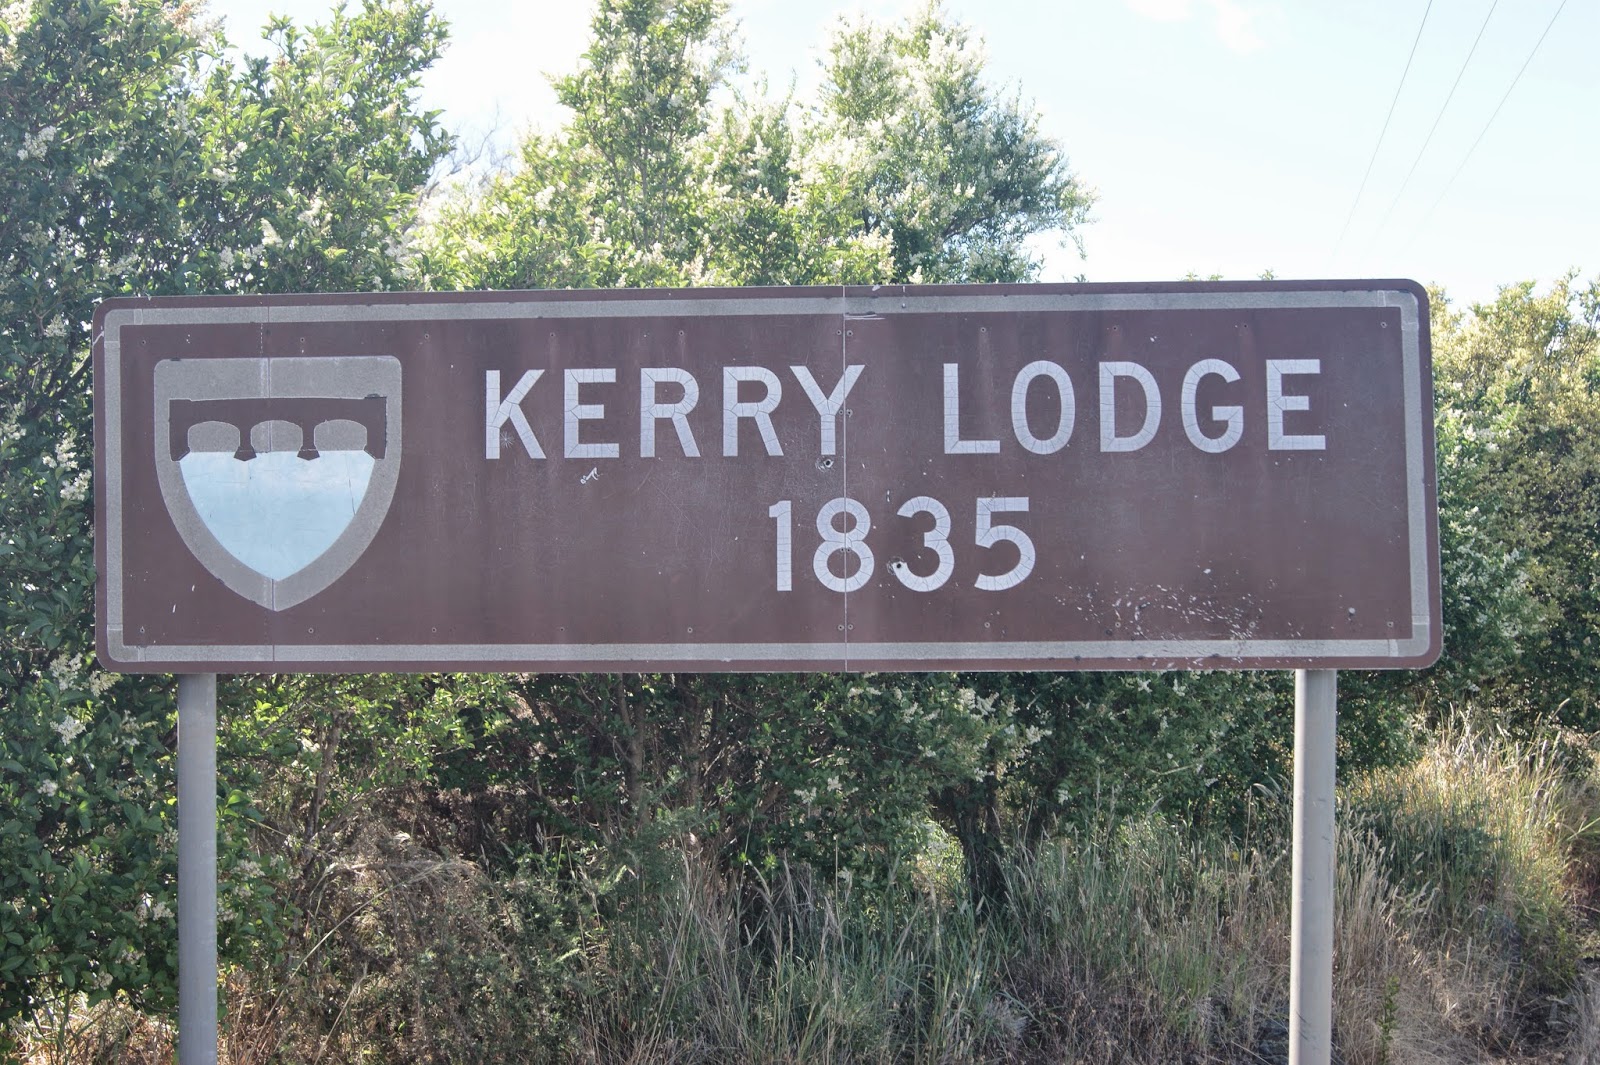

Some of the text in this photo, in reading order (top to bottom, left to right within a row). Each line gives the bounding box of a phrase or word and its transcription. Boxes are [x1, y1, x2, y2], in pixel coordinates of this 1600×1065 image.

[485, 358, 1326, 460] KERRY LODGE
[768, 496, 1036, 593] 1835
